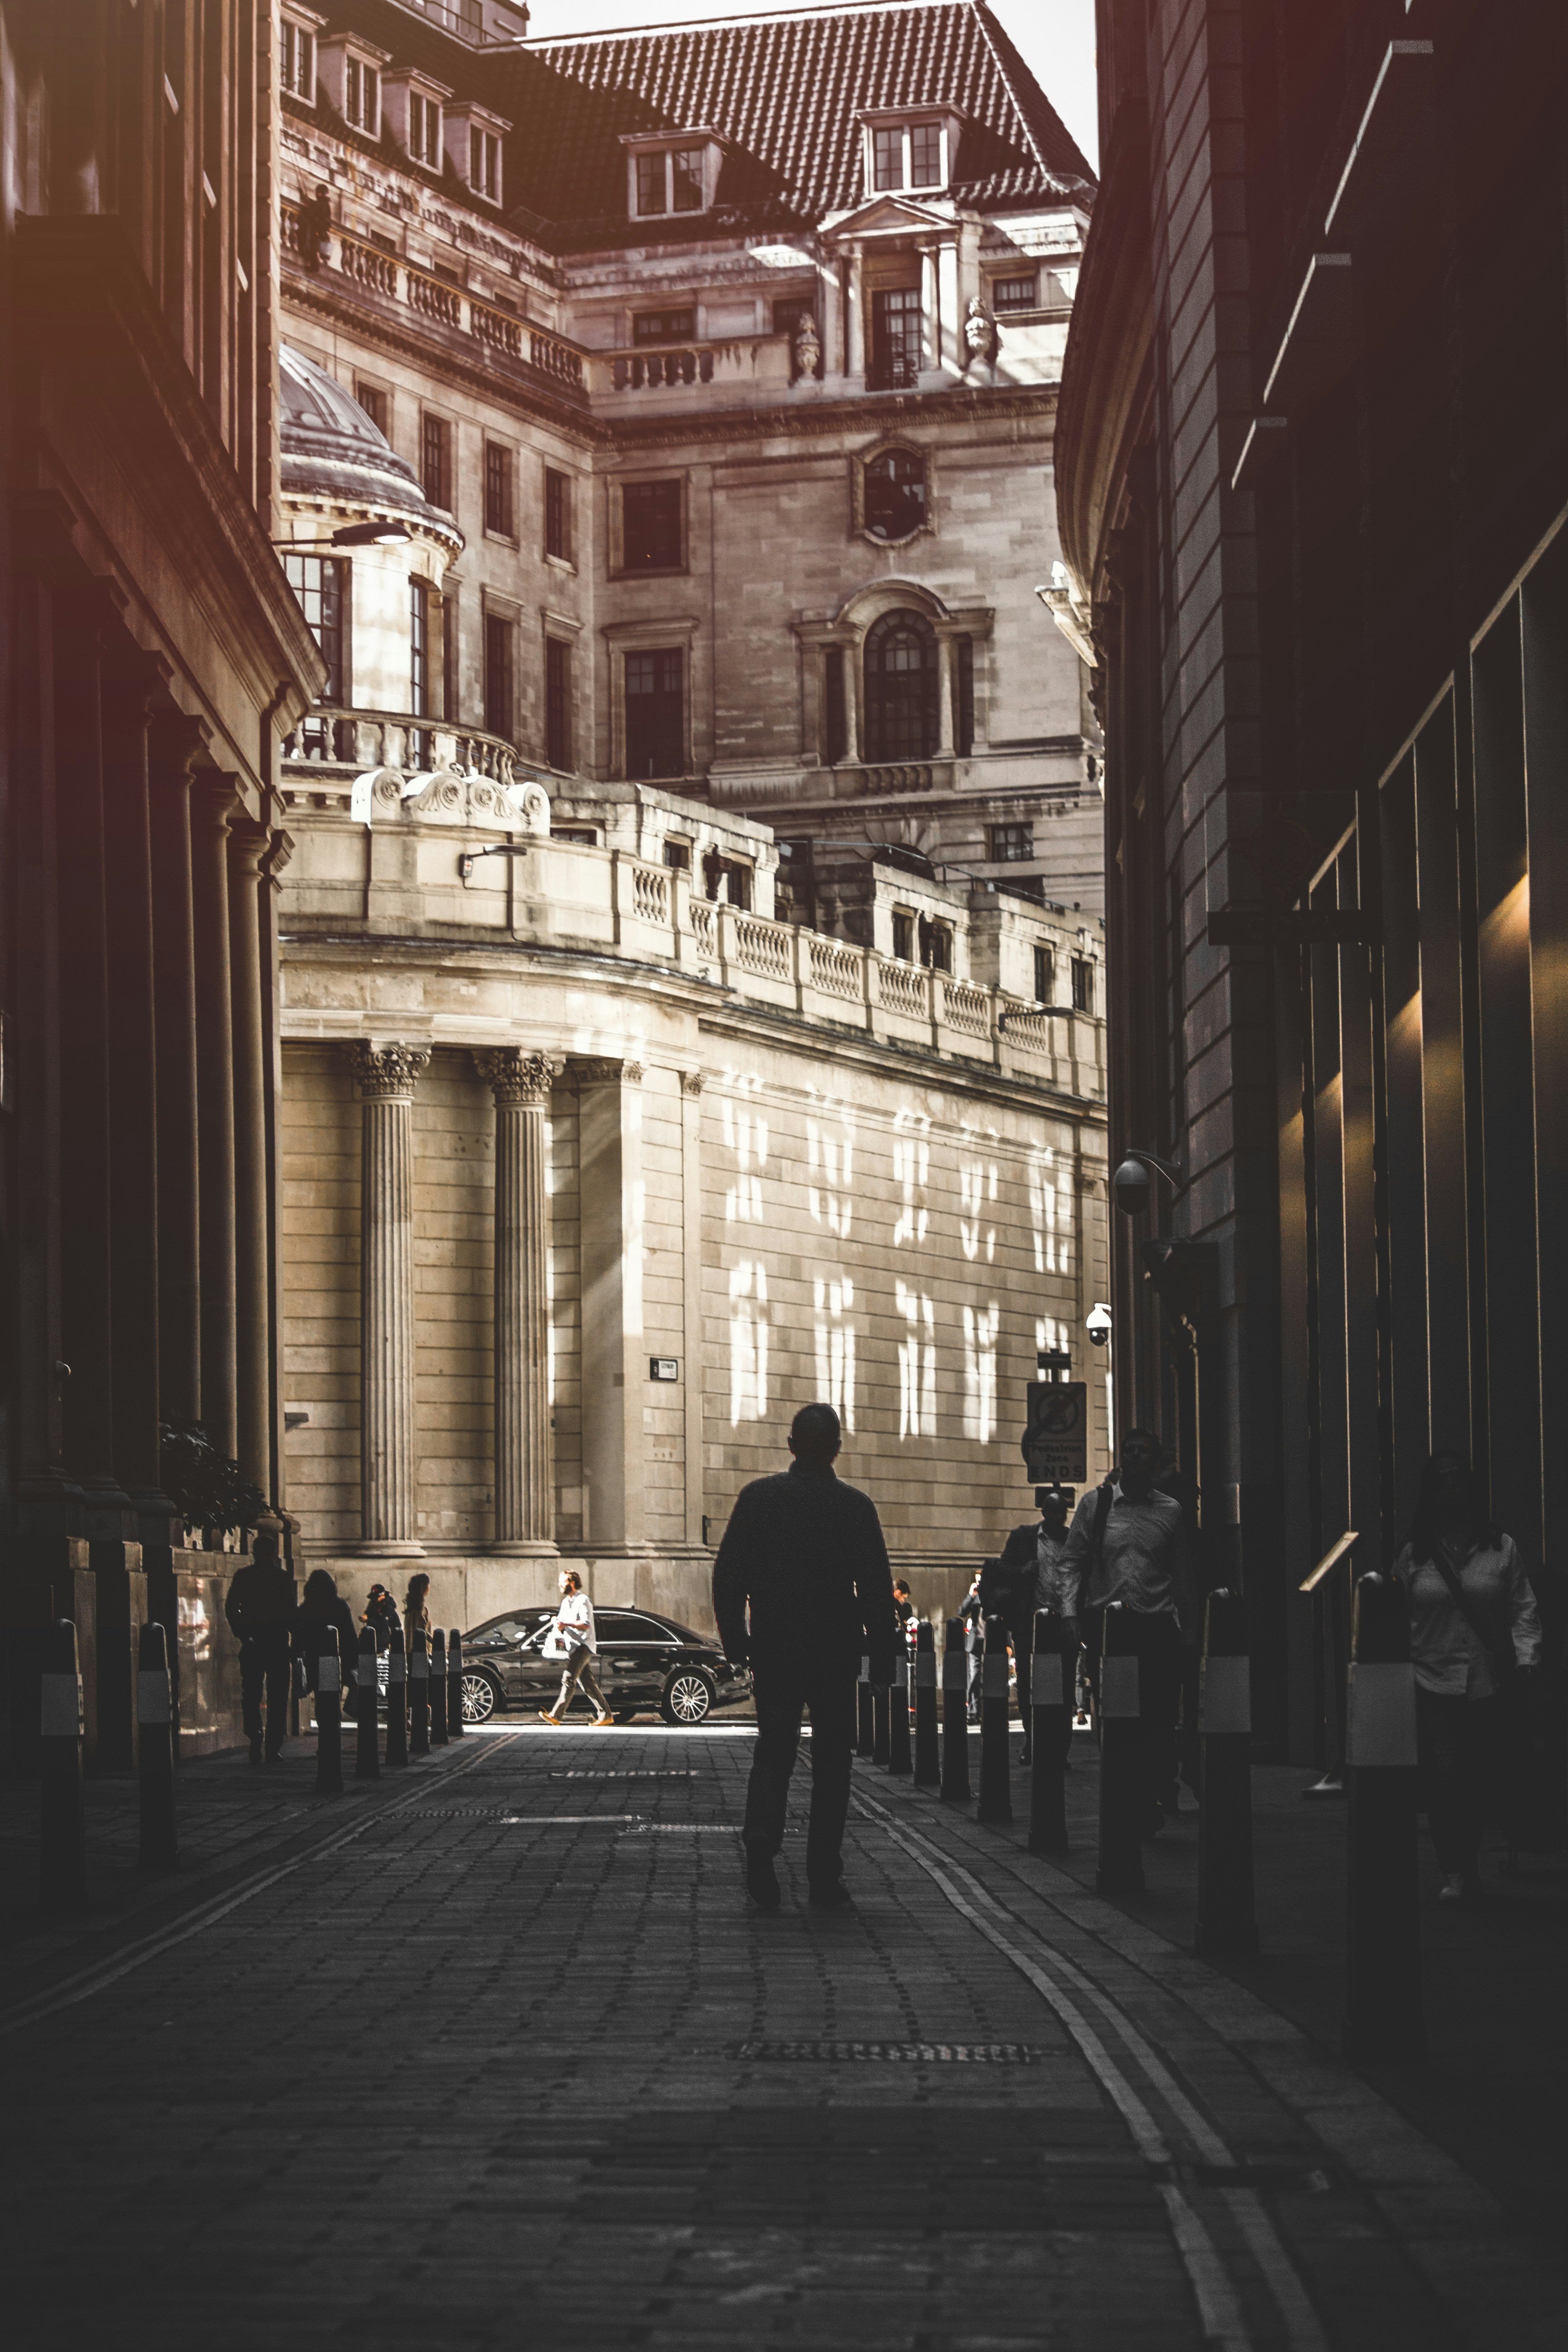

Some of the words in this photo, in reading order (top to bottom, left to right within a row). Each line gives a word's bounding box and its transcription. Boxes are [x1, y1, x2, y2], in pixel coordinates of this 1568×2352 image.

[1032, 1444, 1083, 1452] Pedestrian
[1045, 1454, 1068, 1462] Zone
[1031, 1465, 1083, 1478] ENDS
